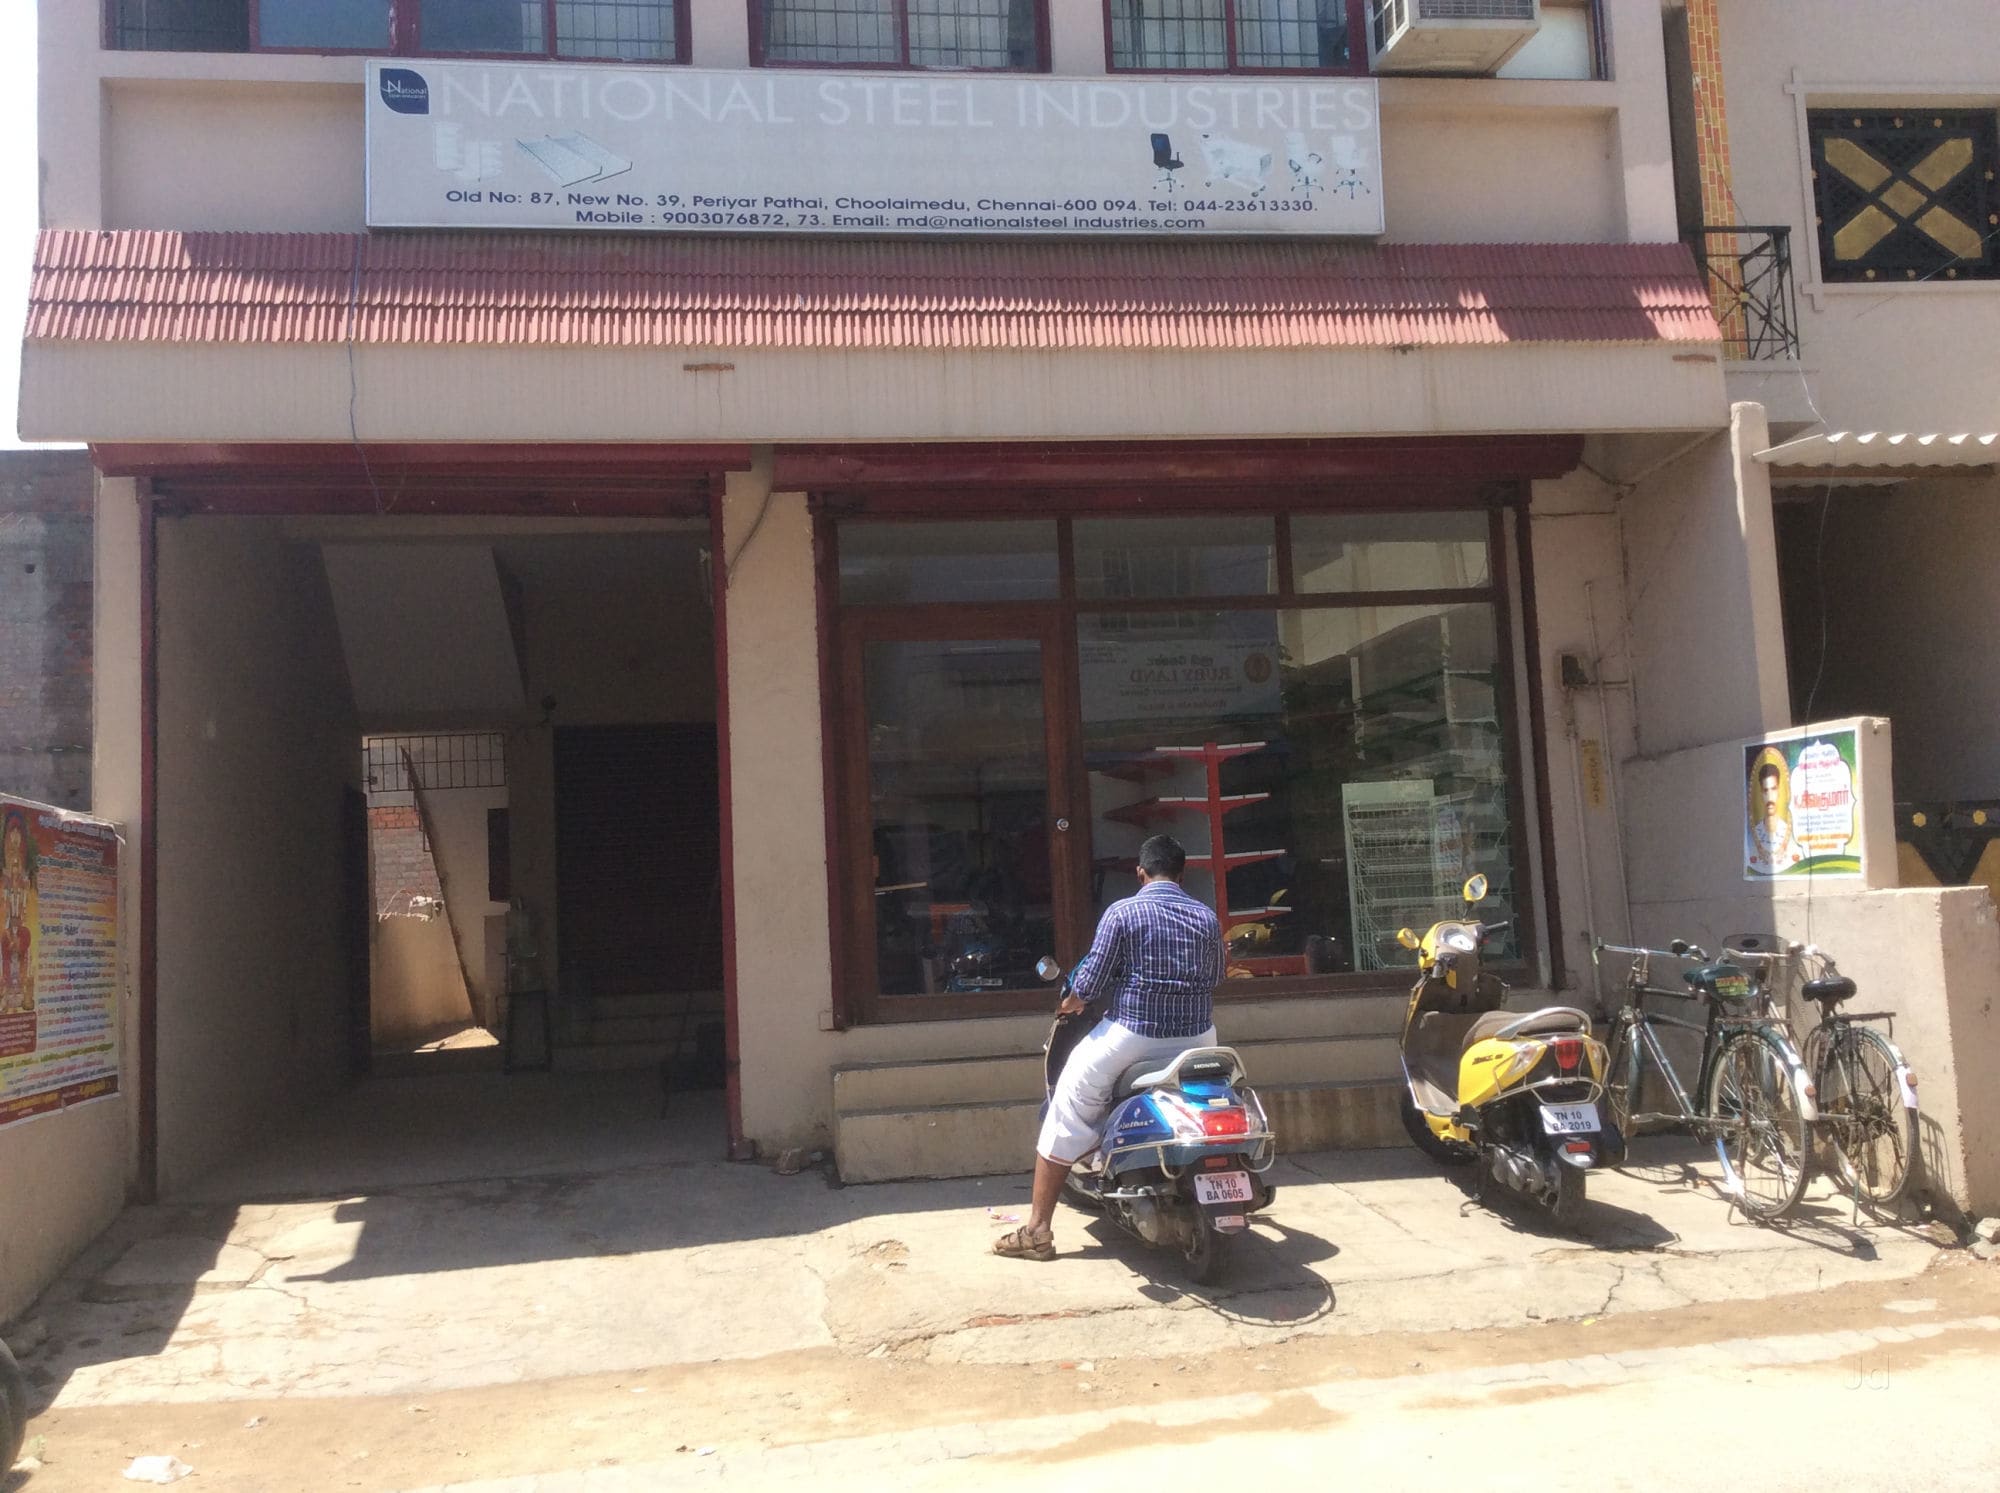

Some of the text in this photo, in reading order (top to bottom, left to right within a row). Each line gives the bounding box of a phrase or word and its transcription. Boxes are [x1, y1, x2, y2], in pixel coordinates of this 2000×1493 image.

[386, 79, 427, 95] National
[442, 72, 1374, 131] NATIONAL STEEL INDUSTRIES
[446, 190, 1318, 212] Old No: 87, New No. 39, Periyar Pathai, Choolaimedu, Chennai-600 094. Tel: 044-23613330.
[576, 210, 644, 224] Mobile
[662, 212, 790, 227] 9003076872,
[797, 213, 826, 227] 73.
[832, 214, 890, 228] Email:
[896, 214, 1068, 230] md@nationalsteel
[1073, 216, 1206, 230] industries.com
[1554, 1111, 1583, 1120] TN 10
[1568, 1120, 1592, 1131] 2019
[1209, 1178, 1237, 1191] TN 10
[1206, 1188, 1244, 1201] BA 0605
